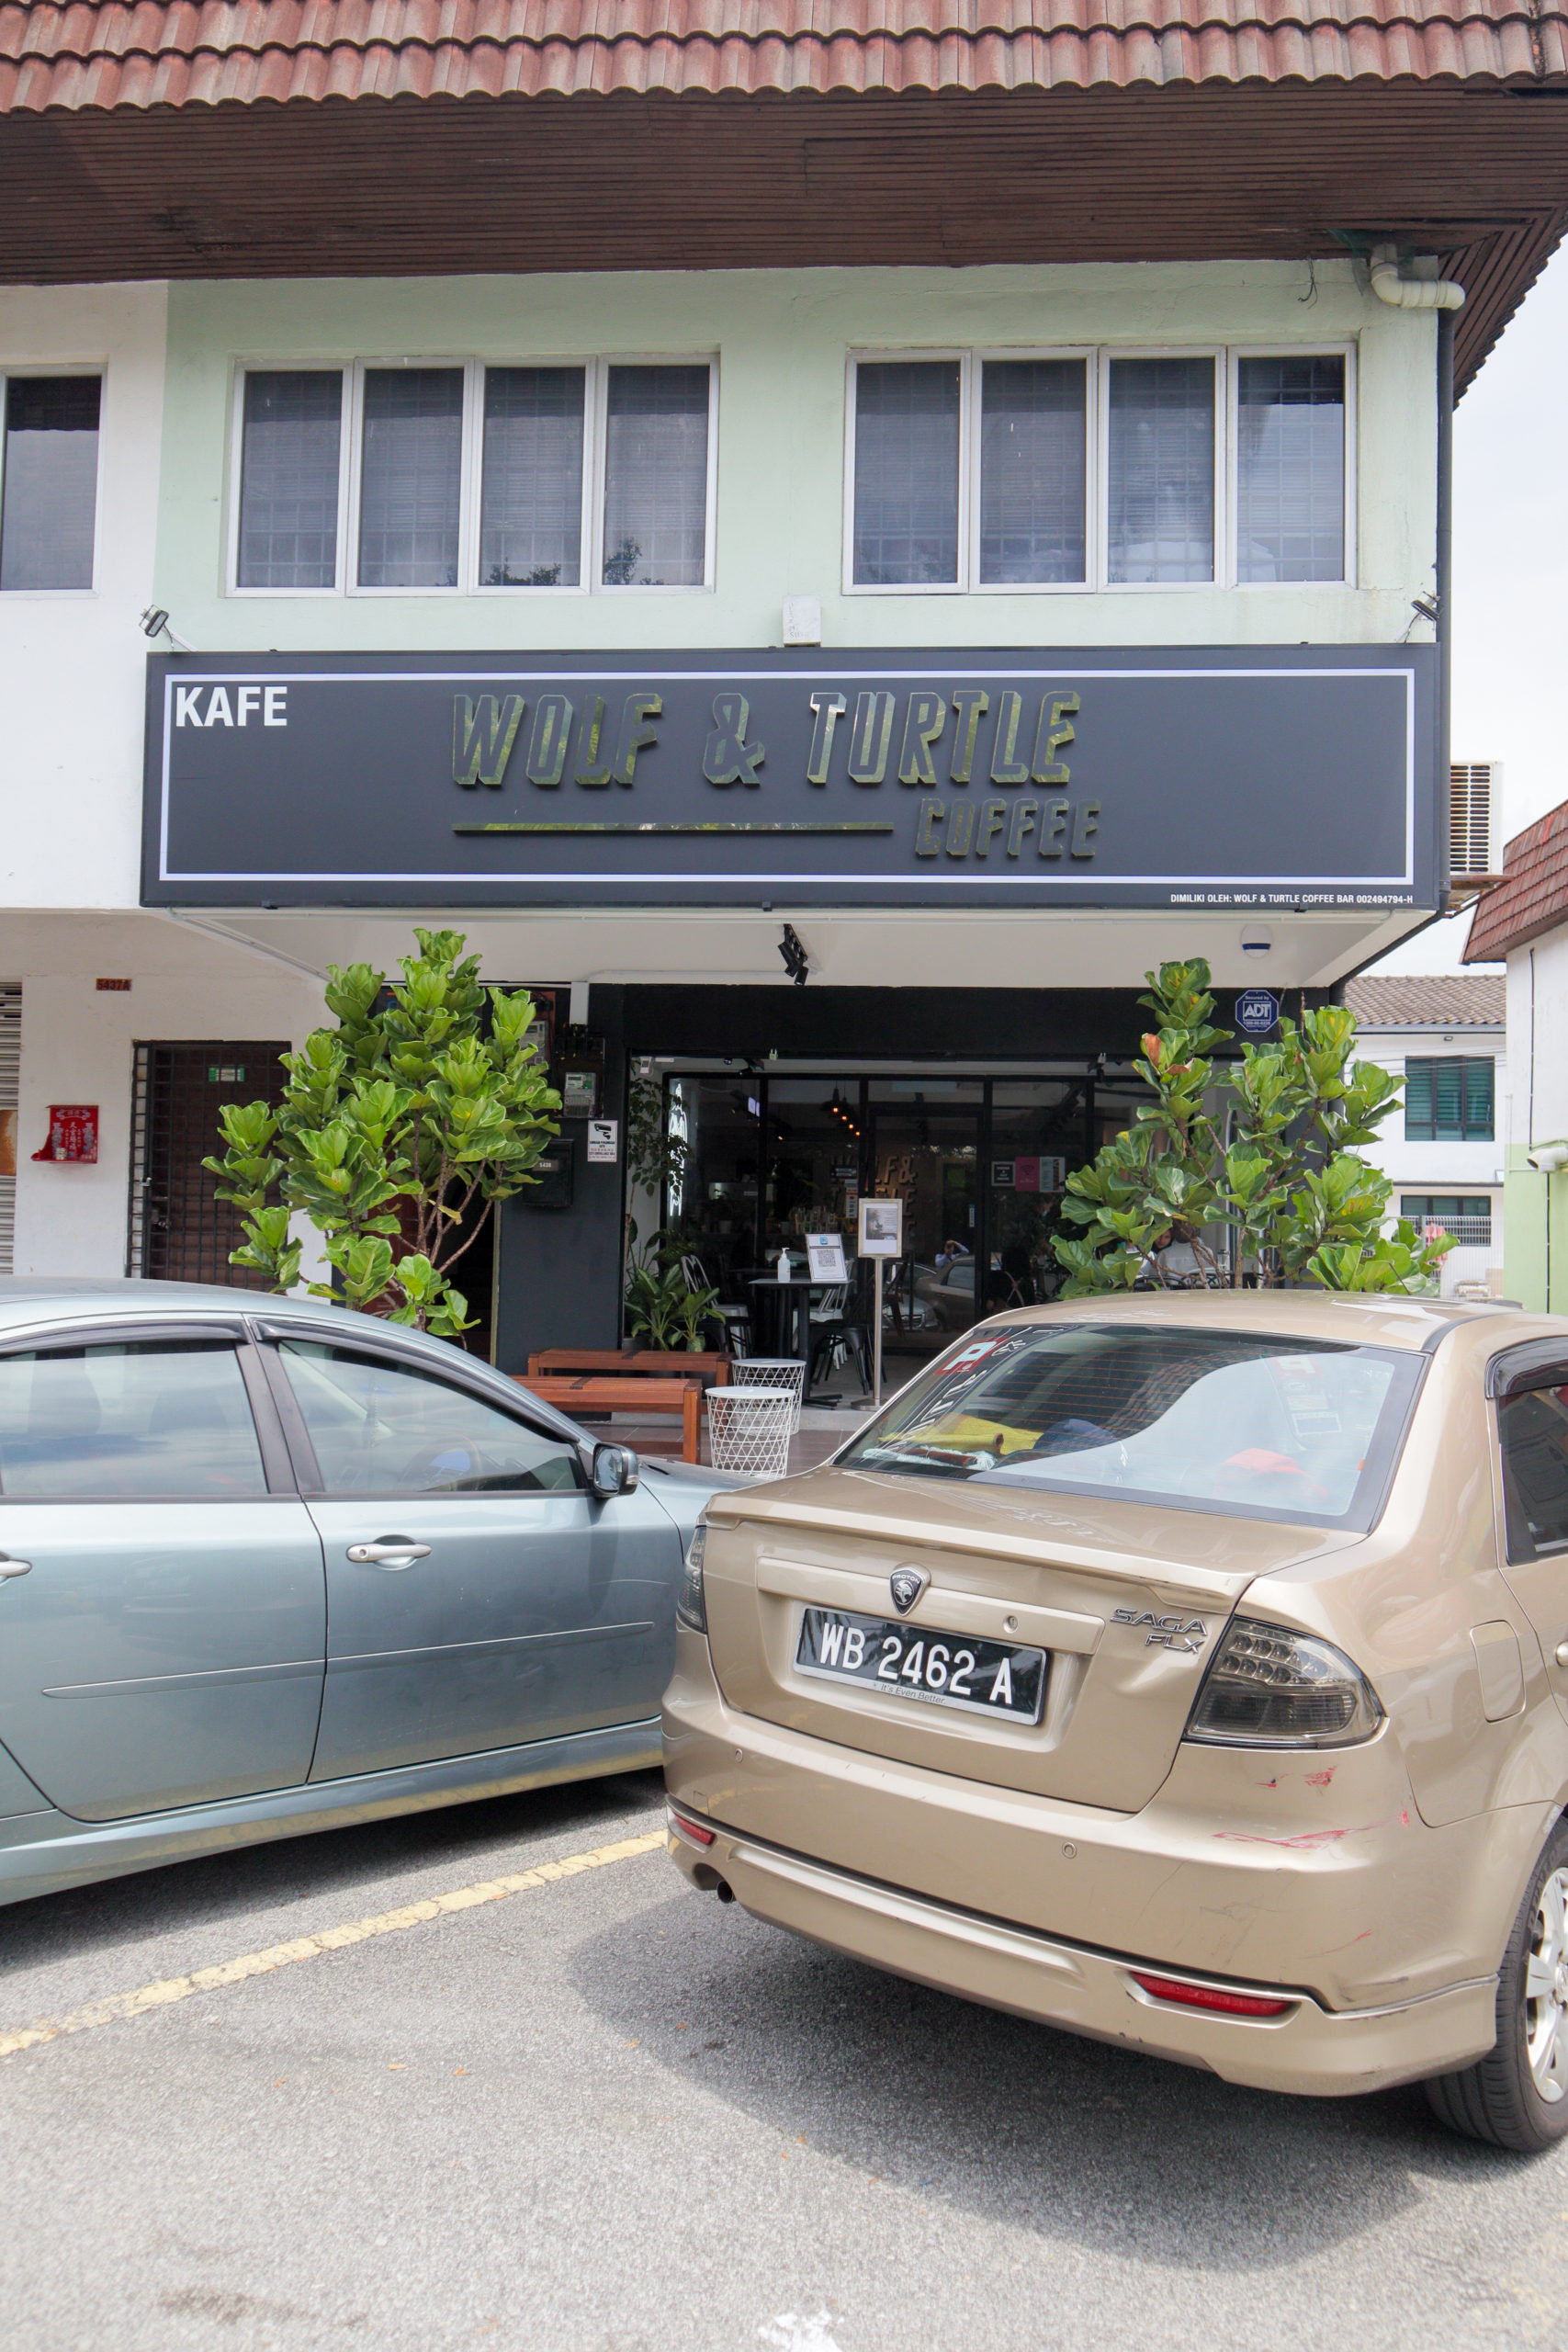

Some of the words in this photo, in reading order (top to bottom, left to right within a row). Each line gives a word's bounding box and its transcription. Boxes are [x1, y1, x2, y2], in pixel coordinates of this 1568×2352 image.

[176, 686, 287, 727] KAFE
[452, 694, 662, 785] WOLF
[703, 694, 765, 785] &
[807, 691, 1081, 784] TURTLE
[915, 797, 1100, 856] COFFEE
[1170, 893, 1205, 903] DIMILIKI
[1207, 893, 1232, 903] OLEH:
[1234, 893, 1258, 903] WOLF
[1259, 894, 1267, 903] &
[1268, 894, 1300, 903] TURTLE
[1302, 894, 1335, 903] COFFEE
[1337, 894, 1355, 903] BAR
[1356, 894, 1414, 904] 002494794-H
[1244, 1004, 1271, 1018] ADT
[942, 1340, 998, 1371] P
[892, 1574, 919, 1584] PROTON
[1110, 1607, 1207, 1635] SAGA
[1145, 1634, 1205, 1654] FLX
[819, 1622, 865, 1669] WB
[878, 1635, 976, 1695] 2462
[989, 1657, 1012, 1704] A
[881, 1683, 894, 1693] It's
[895, 1687, 916, 1697] Even
[918, 1691, 946, 1704] Better.
